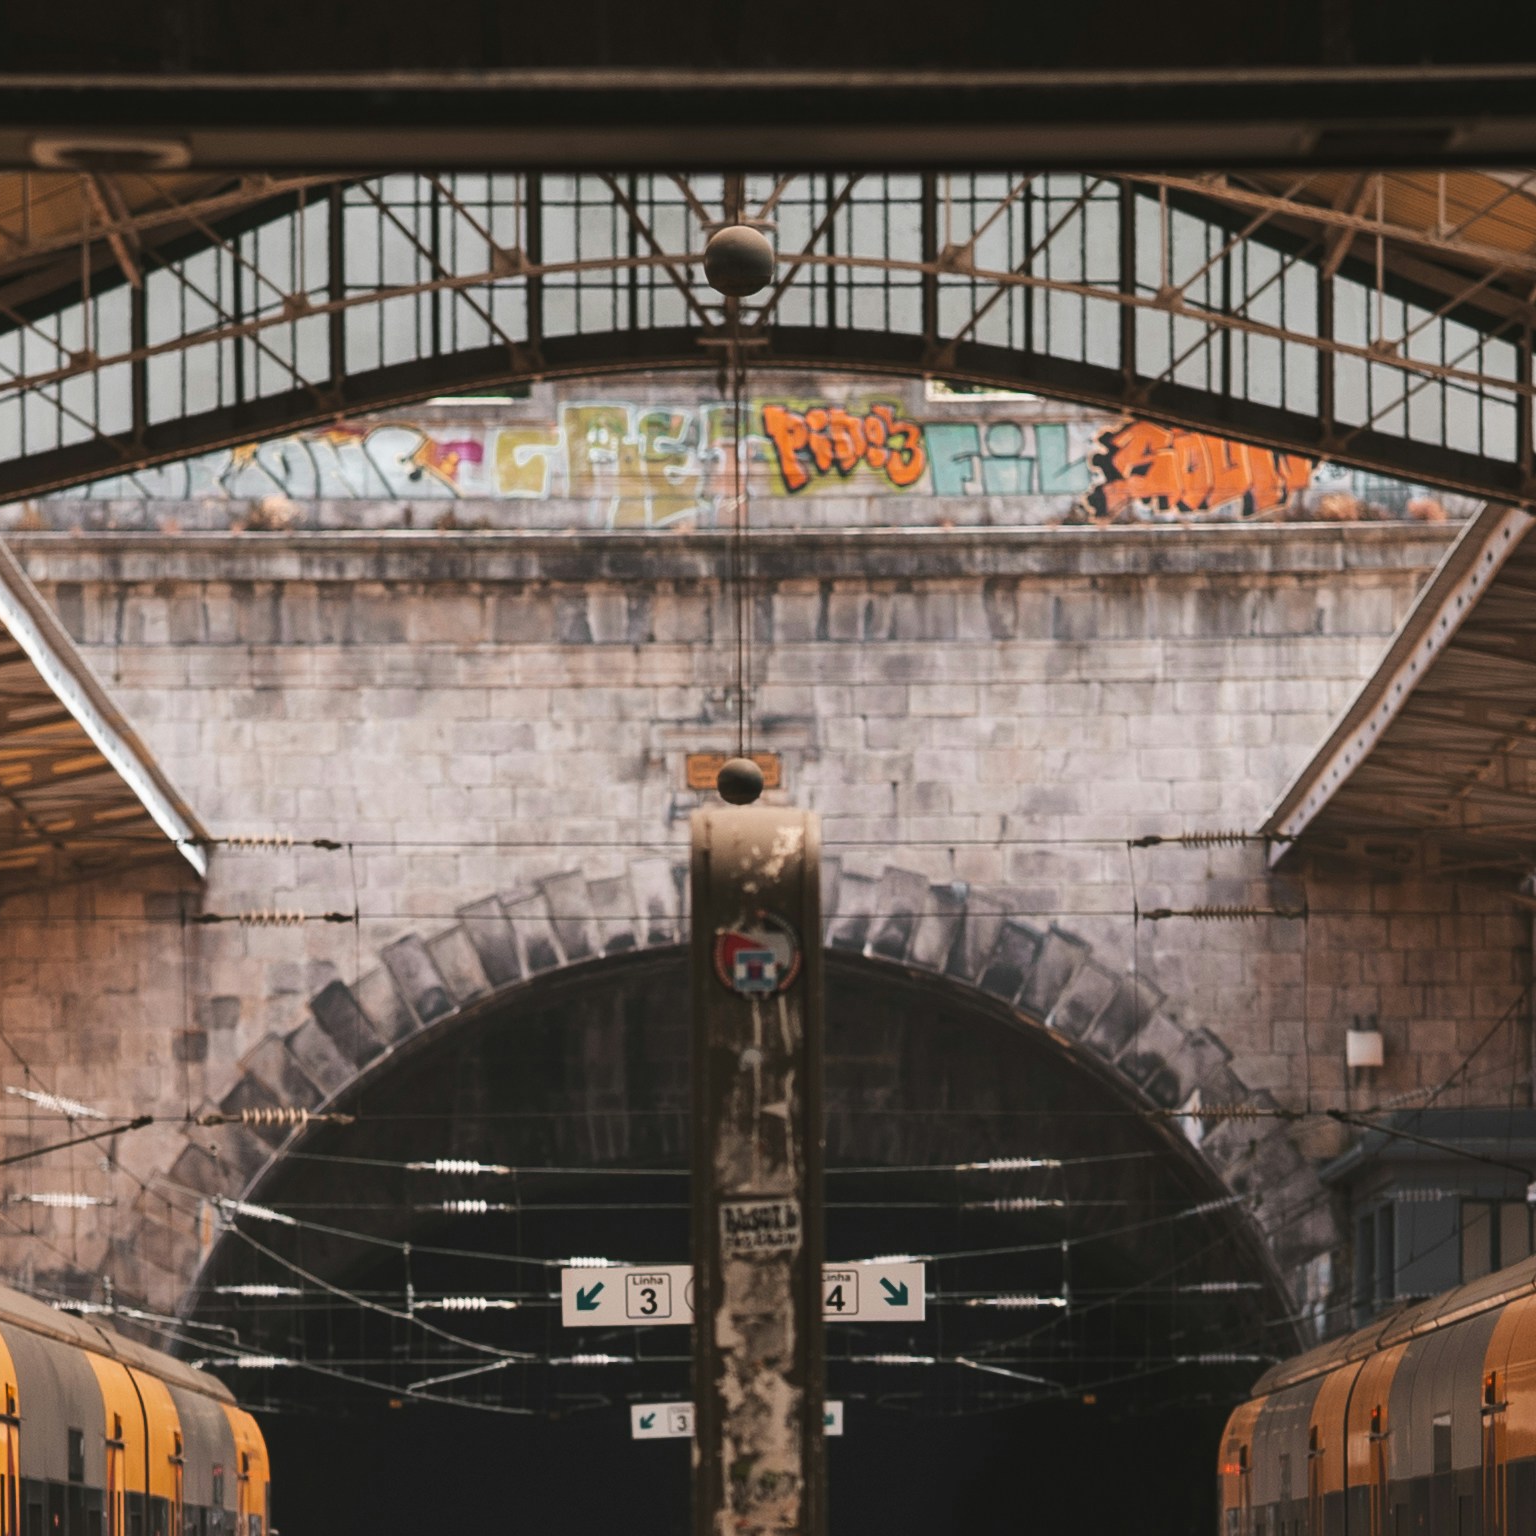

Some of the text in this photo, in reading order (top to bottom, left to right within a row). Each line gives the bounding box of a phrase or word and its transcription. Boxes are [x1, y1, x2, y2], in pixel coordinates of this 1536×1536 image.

[632, 1276, 664, 1286] Linha
[640, 1288, 658, 1315] 3
[825, 1284, 846, 1312] 4
[677, 1414, 687, 1432] 3
